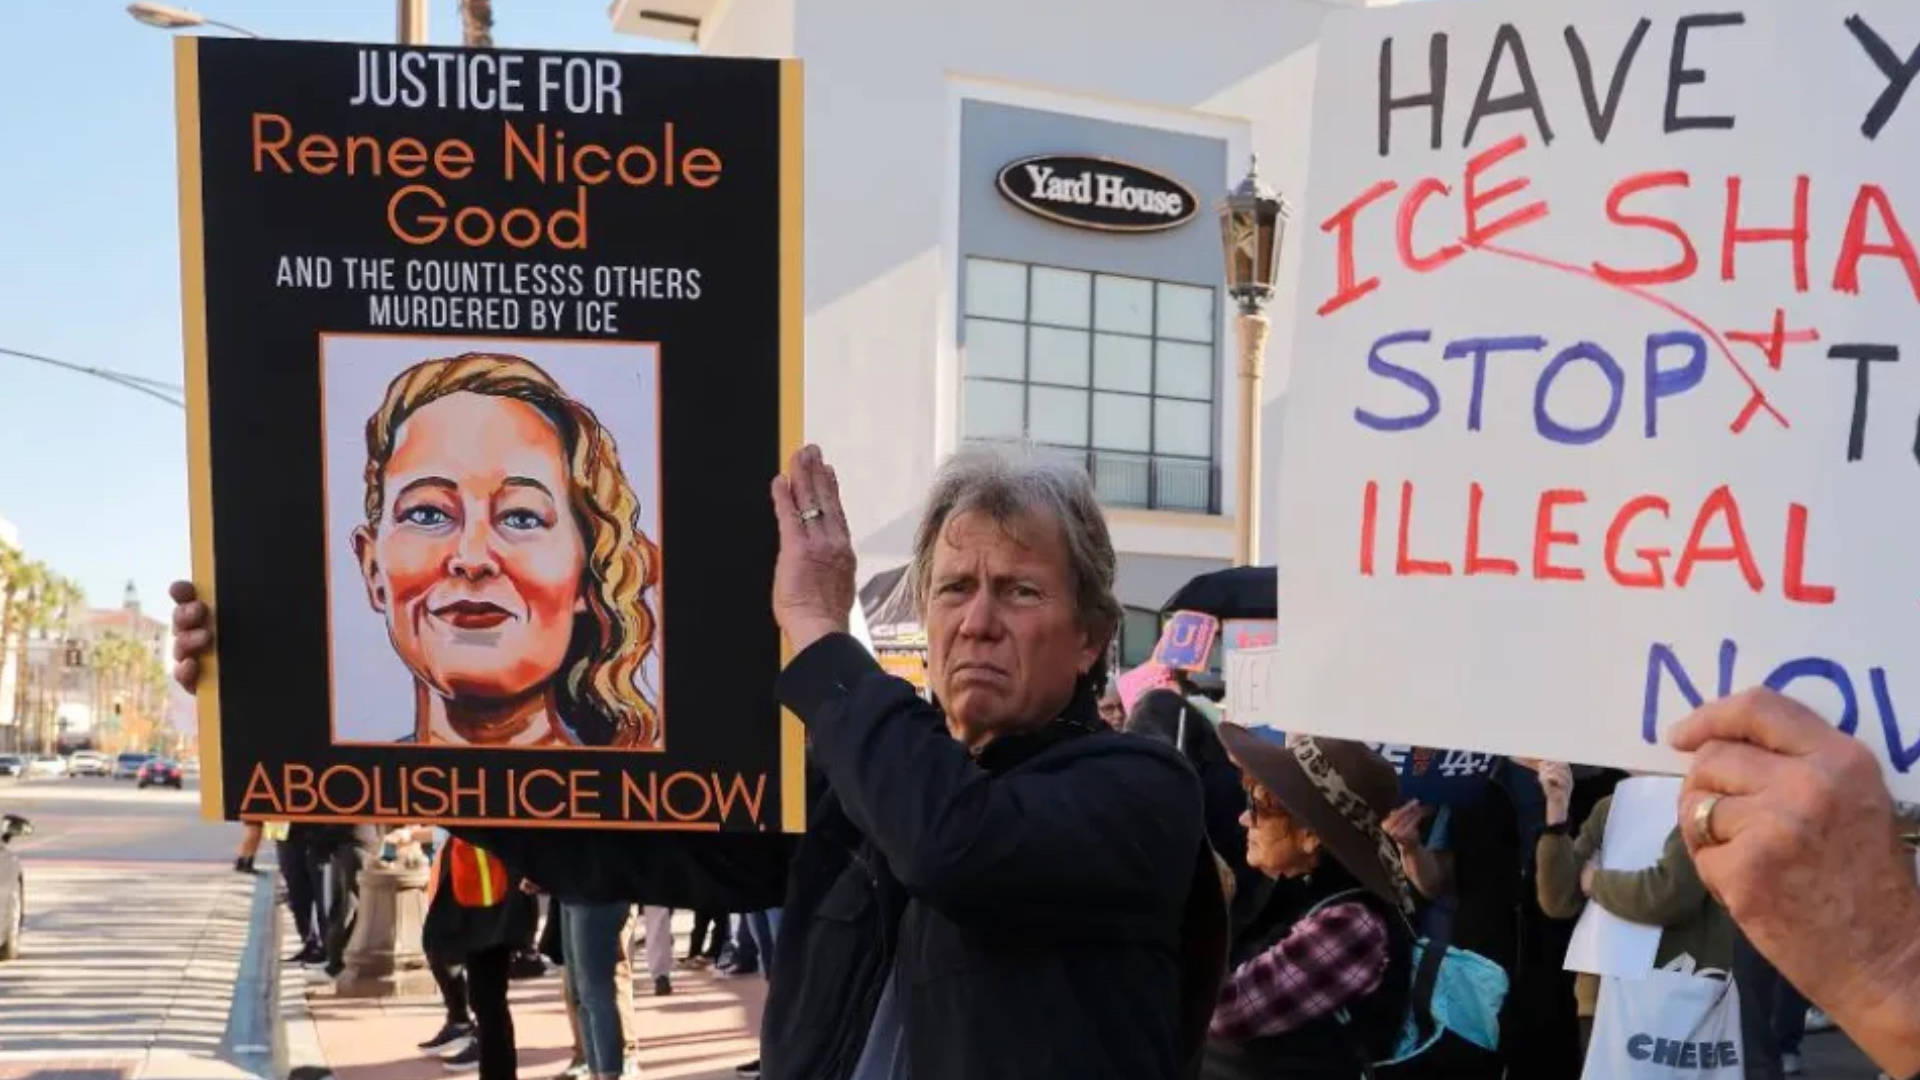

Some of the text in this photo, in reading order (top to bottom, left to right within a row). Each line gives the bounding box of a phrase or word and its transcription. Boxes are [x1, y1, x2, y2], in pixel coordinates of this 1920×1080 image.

[350, 50, 624, 115] JUSTICE FOR
[1378, 12, 1746, 156] HAVE
[252, 113, 723, 188] Renee Nicole
[386, 184, 589, 250] Good
[1024, 164, 1184, 217] Yard House
[1317, 134, 1550, 316] ICE
[276, 256, 702, 300] AND THE COUNTLESSS OTHERS
[369, 295, 620, 333] MURDERED BY ICE
[1354, 329, 1708, 445] STOP
[1827, 343, 1920, 468] T
[1360, 480, 1836, 605] ILLEGAL
[241, 761, 486, 818] ABOLISH
[507, 768, 601, 820] ICE
